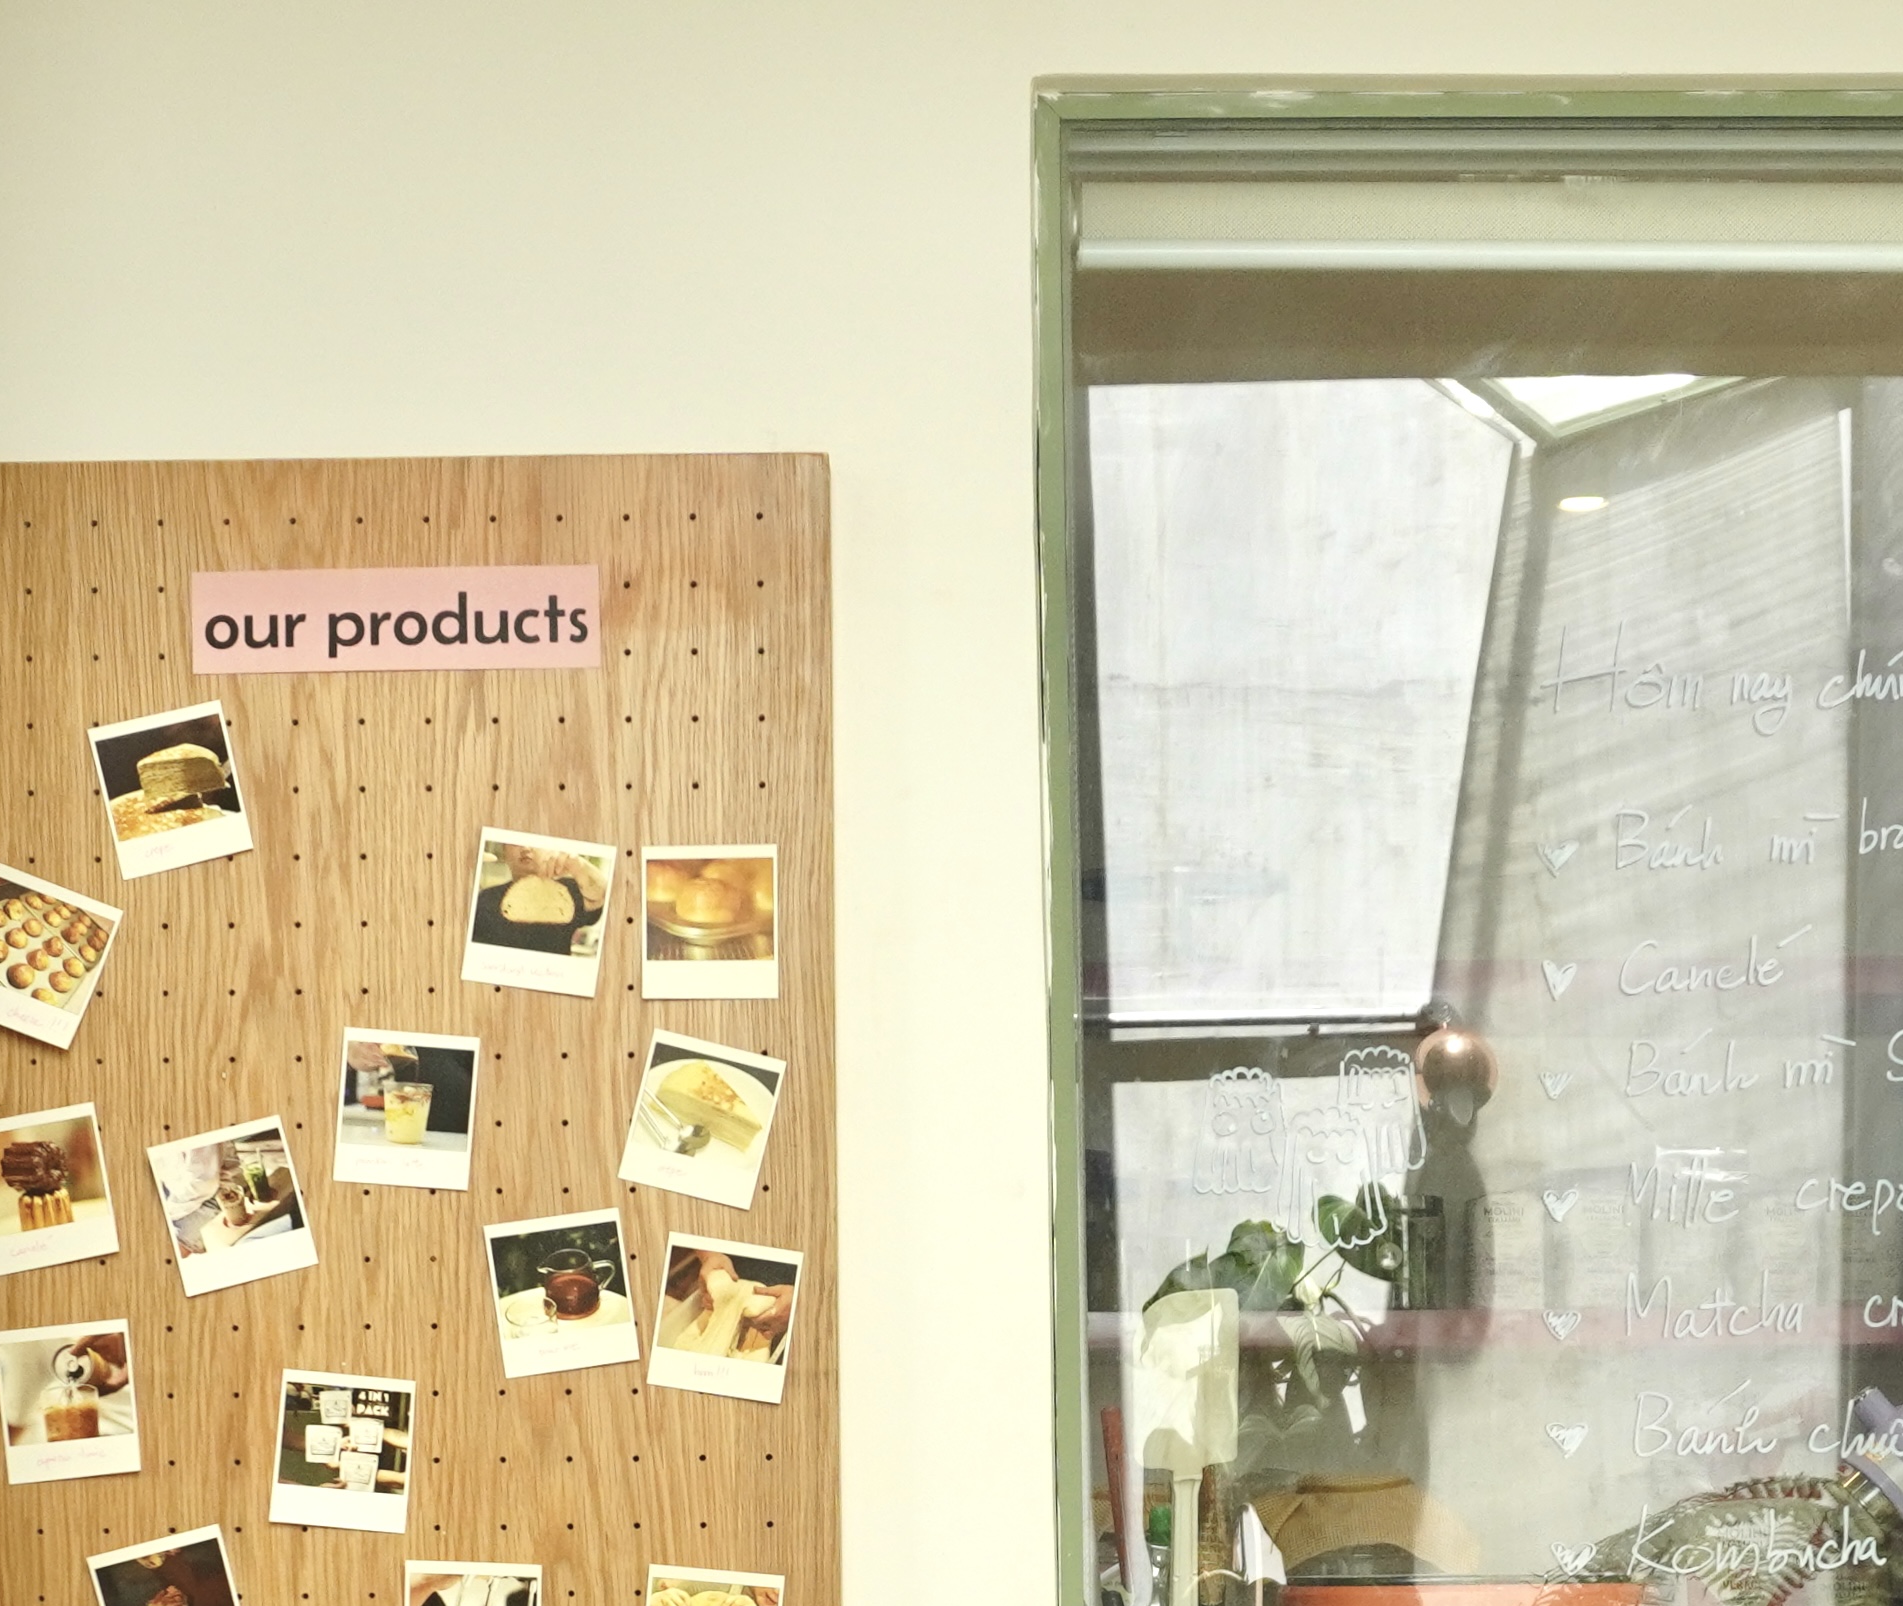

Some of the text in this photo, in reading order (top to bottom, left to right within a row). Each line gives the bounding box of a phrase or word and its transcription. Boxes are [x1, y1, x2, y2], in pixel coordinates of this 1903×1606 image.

[204, 592, 590, 659] our products
[1730, 671, 1793, 736] nay
[1613, 804, 1724, 872] Bánh
[1617, 925, 1813, 999] Canelé
[1622, 1028, 1760, 1099] Bánh
[1624, 1270, 1804, 1340] Matcha
[356, 1403, 390, 1417] PACK
[1633, 1380, 1777, 1460] Bánh
[1629, 1506, 1888, 1577] Kombucha
